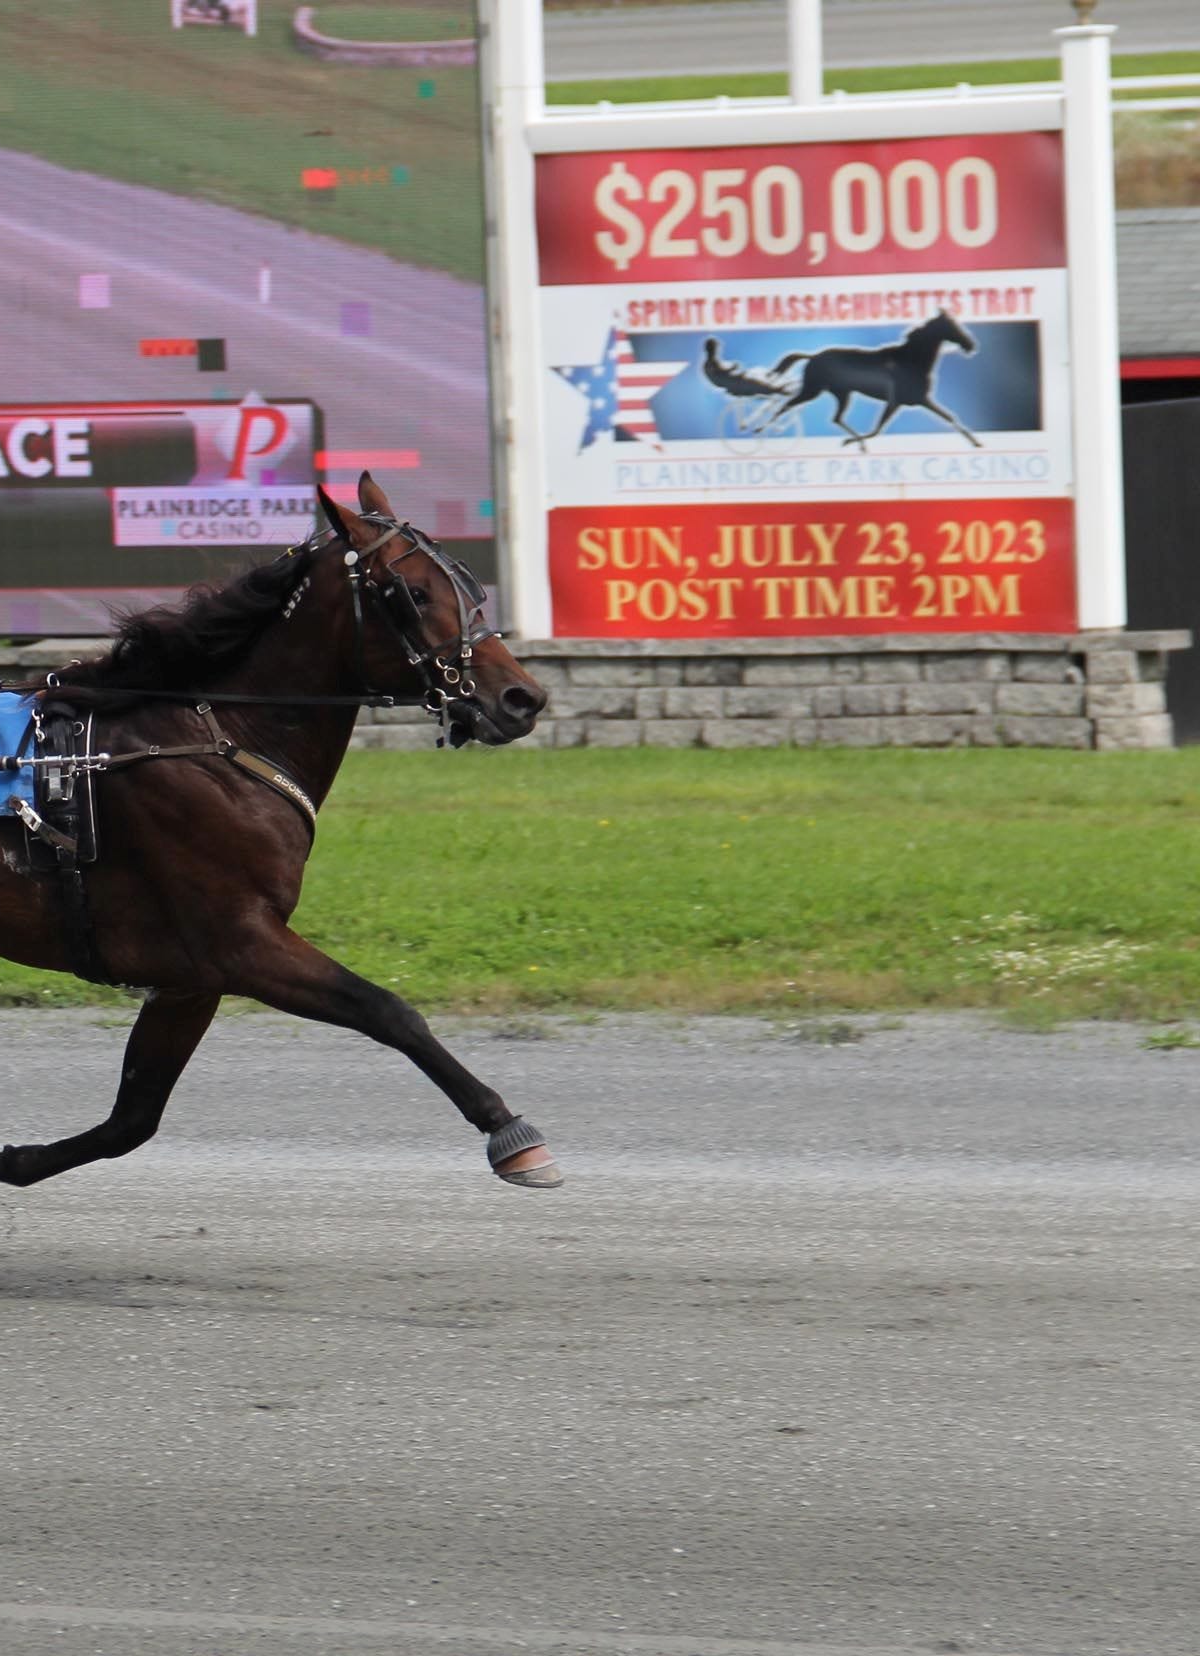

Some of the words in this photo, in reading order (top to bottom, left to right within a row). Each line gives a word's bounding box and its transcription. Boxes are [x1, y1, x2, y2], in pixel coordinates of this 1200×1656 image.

[594, 157, 998, 270] $250,000
[627, 299, 707, 326] SPIRIT
[713, 298, 741, 324] OF
[748, 290, 964, 324] MASSACHUSETTS
[970, 287, 1035, 315] TROT
[616, 460, 808, 489] PLAINRIDGE
[826, 458, 906, 484] PARK
[921, 454, 1049, 482] CASINO
[119, 499, 251, 519] PLAINRIDGE
[261, 497, 316, 516] PARK
[179, 520, 263, 540] CASINO
[578, 527, 698, 576] SUN,
[710, 524, 847, 569] JULY
[858, 522, 926, 573] 23,
[937, 519, 1047, 564] 2023
[605, 577, 744, 621] POST
[754, 575, 898, 619] TIME
[913, 574, 1022, 617] 2PM
